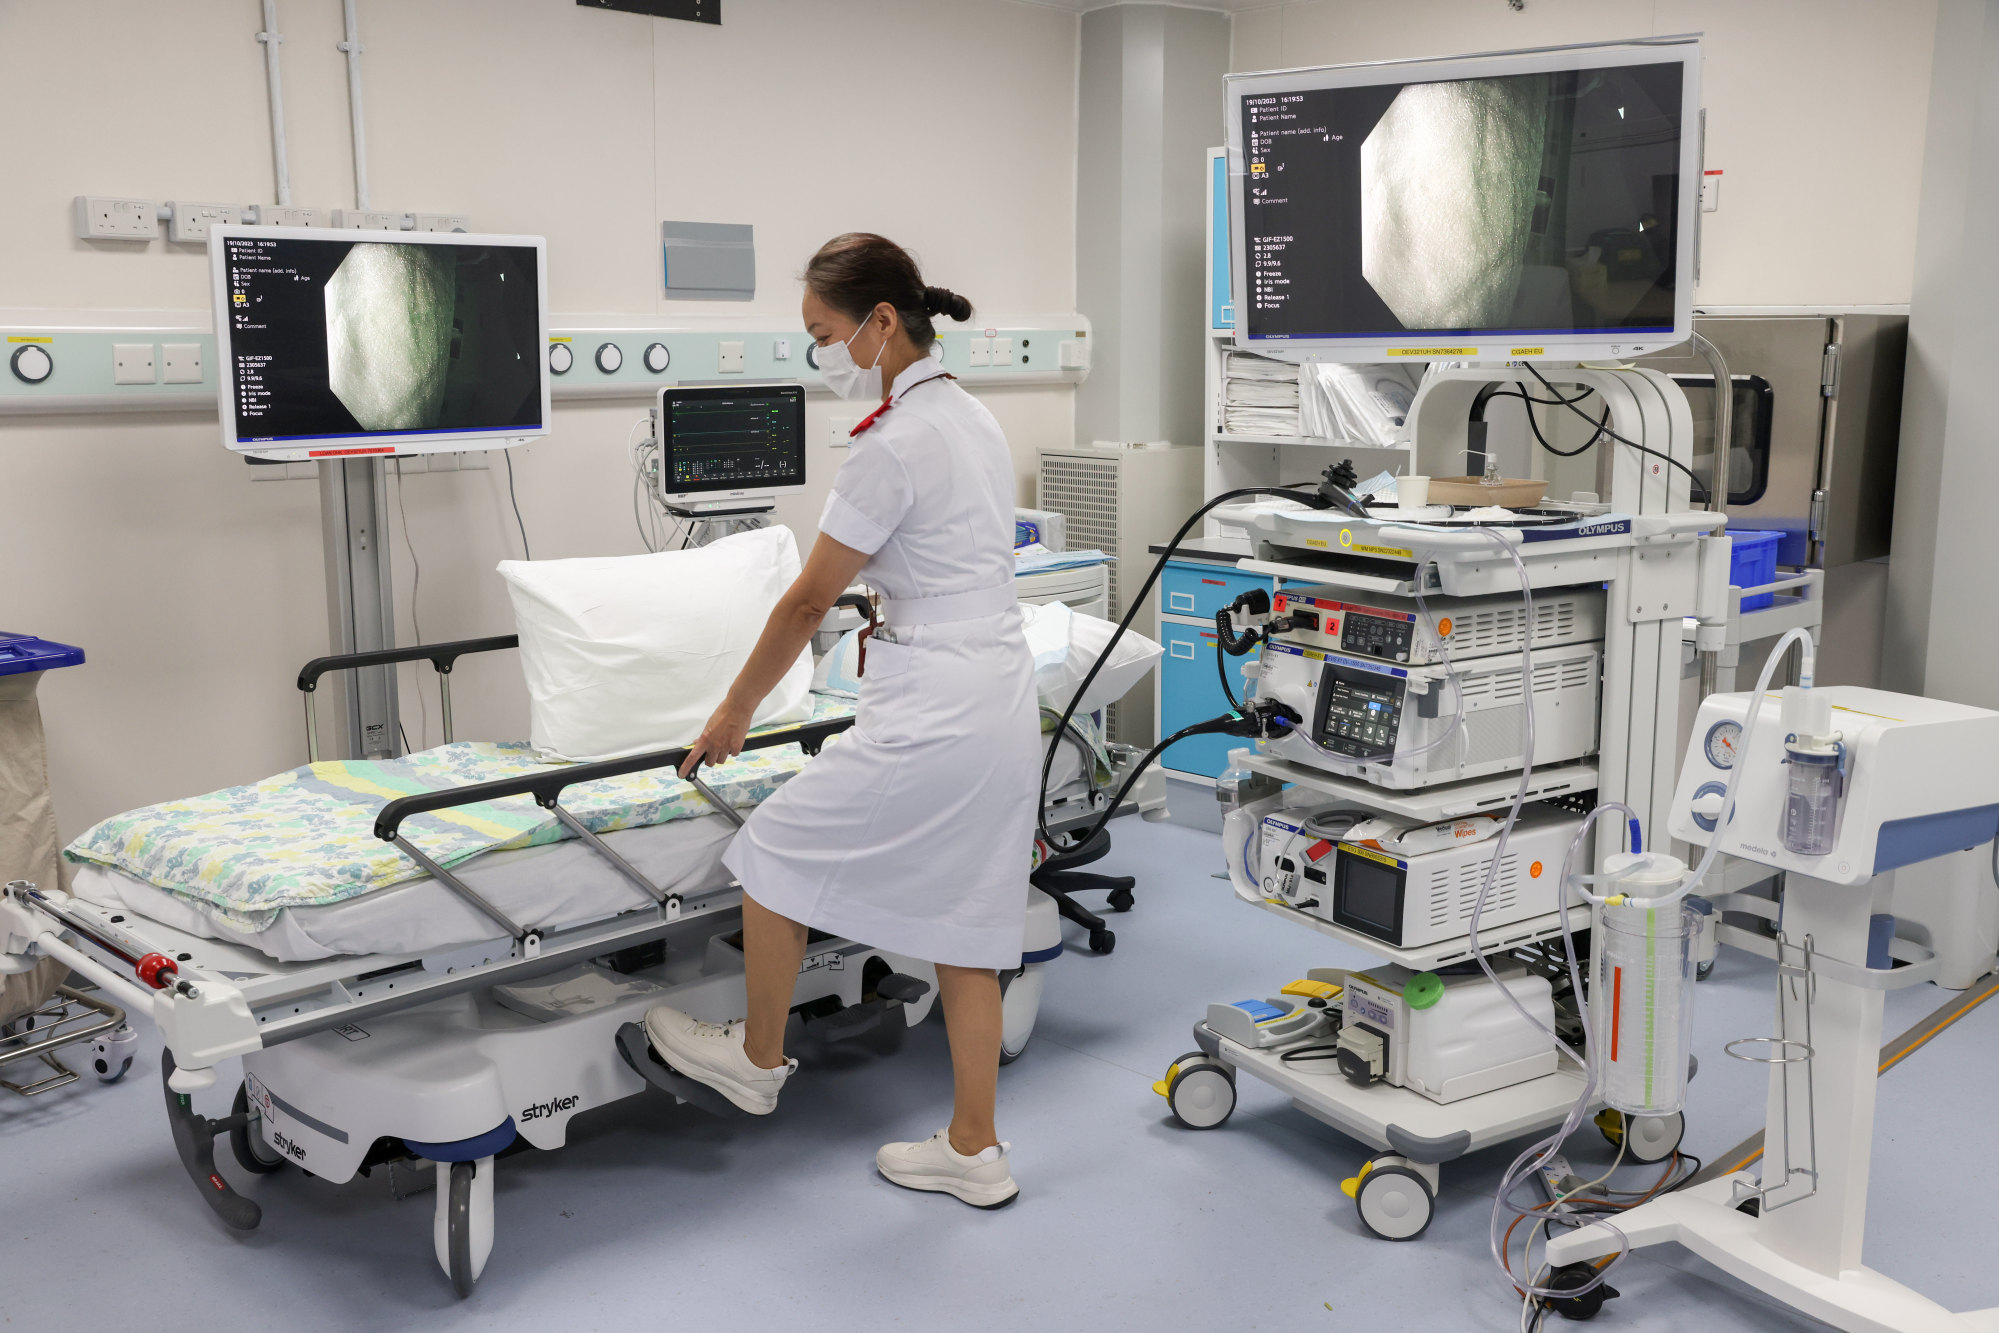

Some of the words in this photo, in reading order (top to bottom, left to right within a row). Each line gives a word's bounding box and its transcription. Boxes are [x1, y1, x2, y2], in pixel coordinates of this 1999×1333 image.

[1578, 523, 1625, 536] OLYMPUS
[1278, 599, 1283, 607] 7
[1329, 622, 1335, 631] 2
[1268, 644, 1292, 653] OLYMPUS
[1266, 819, 1289, 830] OLYMPUS
[1454, 828, 1476, 838] Wipes
[1740, 842, 1768, 855] medela
[521, 1095, 579, 1122] stryker
[273, 1131, 306, 1161] stryker
